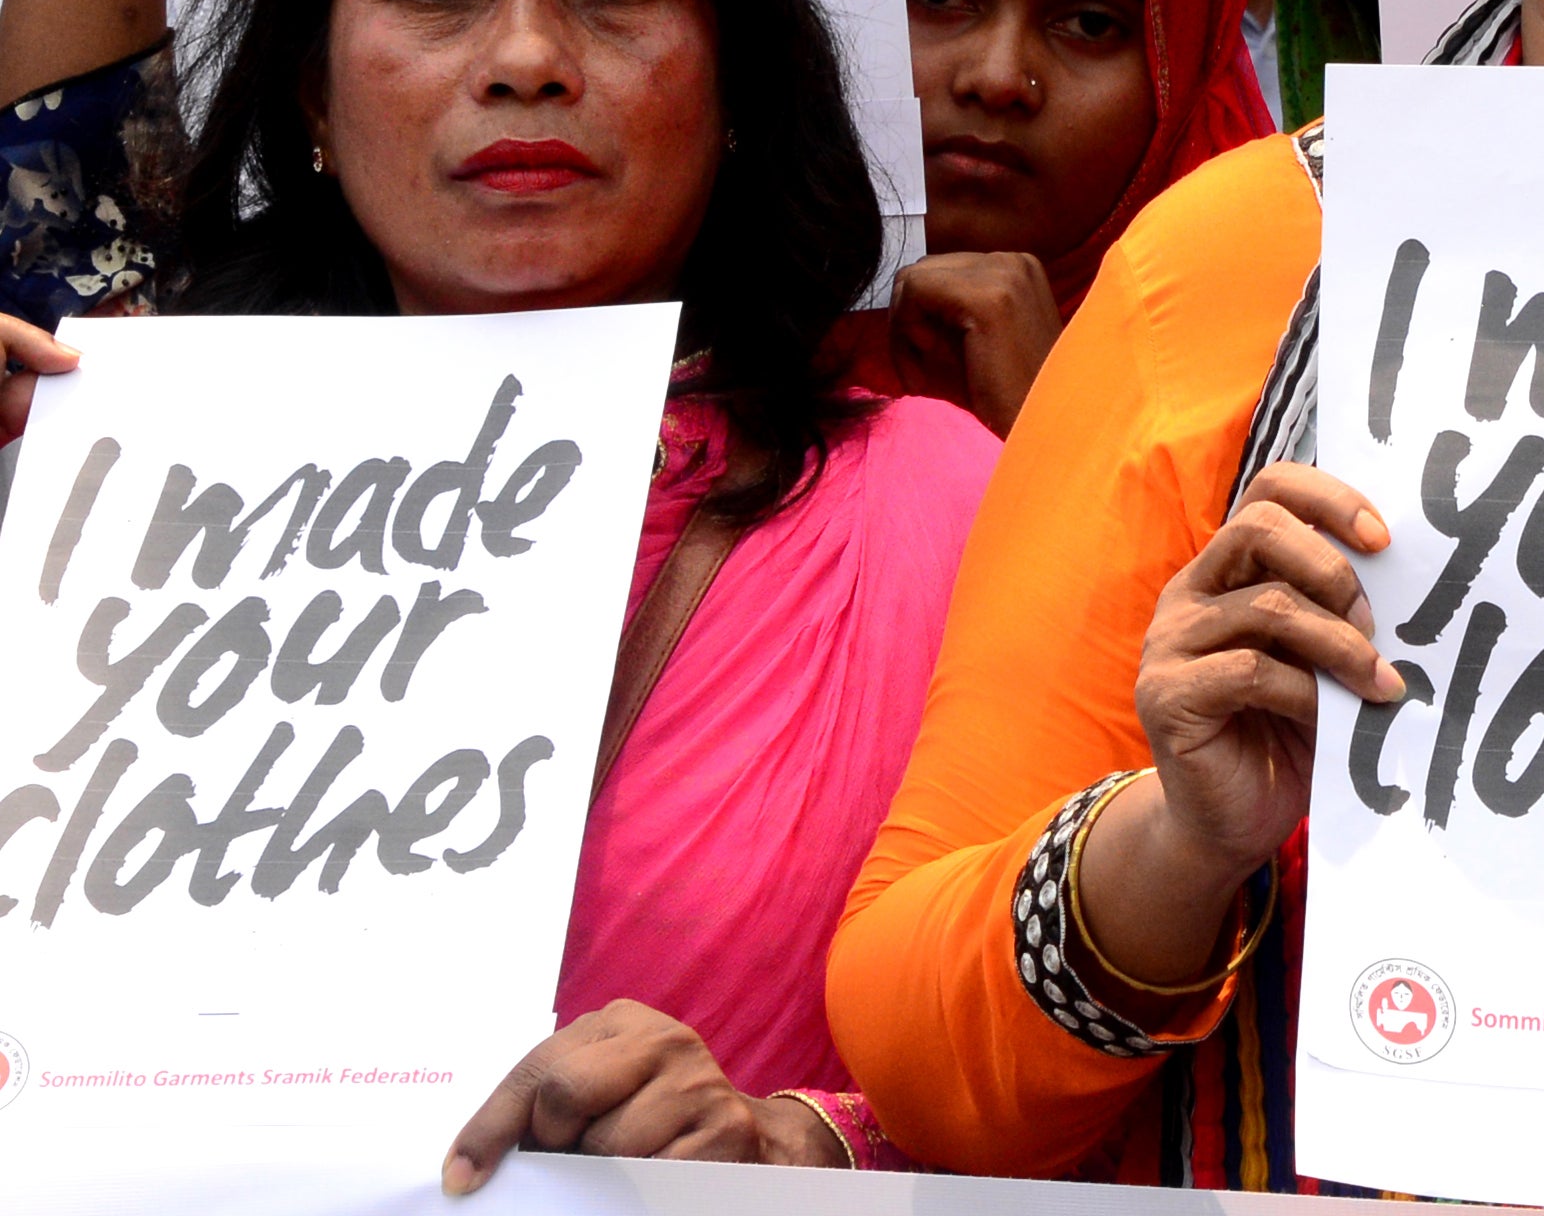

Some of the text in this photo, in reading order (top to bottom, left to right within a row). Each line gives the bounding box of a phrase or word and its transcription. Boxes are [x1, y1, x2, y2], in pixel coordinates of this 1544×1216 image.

[1367, 238, 1431, 445] I
[38, 374, 583, 606] I made
[33, 580, 490, 771] your
[40, 1067, 453, 1088] Sommilito Garments Sramik Federation
